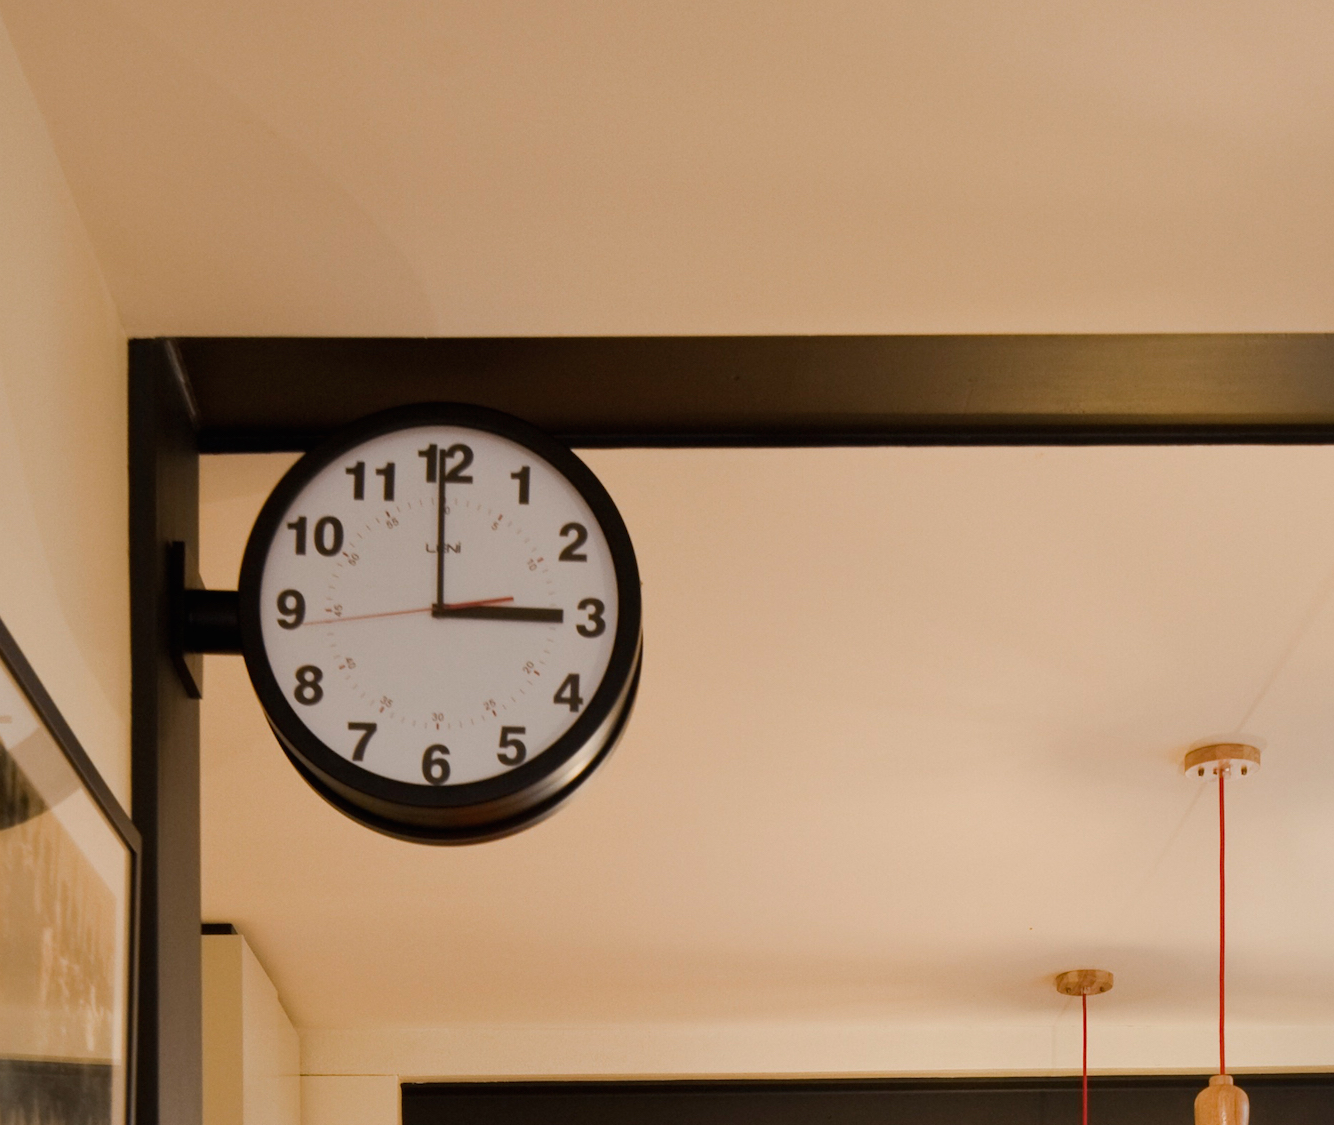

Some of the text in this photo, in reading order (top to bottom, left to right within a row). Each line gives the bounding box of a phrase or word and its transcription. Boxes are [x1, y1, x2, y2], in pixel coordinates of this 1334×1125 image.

[345, 461, 395, 501] 11
[417, 443, 474, 484] 12
[510, 466, 531, 504] 1
[287, 515, 344, 557] 10
[491, 521, 500, 532] 5
[558, 522, 588, 562] 2
[526, 557, 538, 572] 10
[276, 589, 306, 630] 9
[334, 604, 343, 617] 45
[576, 598, 607, 638] 3
[345, 657, 357, 670] 40
[522, 660, 535, 675] 20
[293, 665, 324, 706] 8
[380, 695, 394, 709] 35
[482, 697, 497, 711] 25
[553, 673, 584, 713] 4
[431, 712, 444, 722] 30
[347, 721, 378, 762] 7
[497, 726, 527, 766] 5
[422, 744, 452, 785] 6
